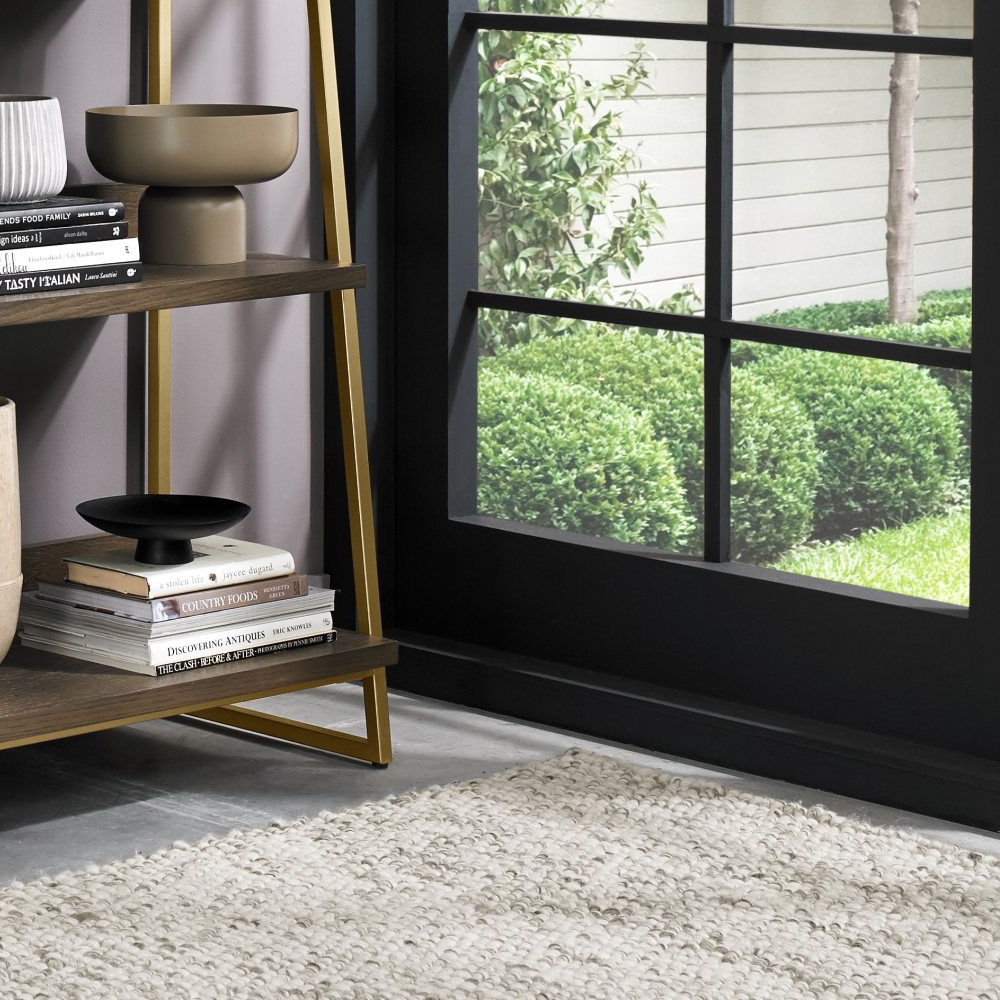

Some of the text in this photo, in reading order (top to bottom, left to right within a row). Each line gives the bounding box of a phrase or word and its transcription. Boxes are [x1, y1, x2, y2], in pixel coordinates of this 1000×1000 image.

[22, 214, 44, 224] FOOD
[45, 212, 72, 222] FAMILY
[10, 234, 29, 243] ideas
[4, 276, 37, 291] TASTY
[39, 273, 81, 288] ITALIAN
[165, 578, 189, 589] stolen
[192, 575, 204, 584] life
[222, 569, 246, 580] jaycee
[248, 562, 274, 577] dugard
[181, 591, 258, 613] COUNTRY FOODS
[167, 622, 312, 657] DISCOVERING ANTIQUES ERIC KNOWLES
[158, 664, 174, 675] THE
[174, 660, 197, 673] CLASH
[200, 654, 225, 666] BEFORE
[225, 653, 232, 662] &
[232, 648, 255, 661] AFTER
[257, 642, 288, 655] PHOTOGRAPHS
[288, 640, 293, 648] BY
[293, 637, 309, 648] PENNIE
[309, 635, 323, 645] SMITH
